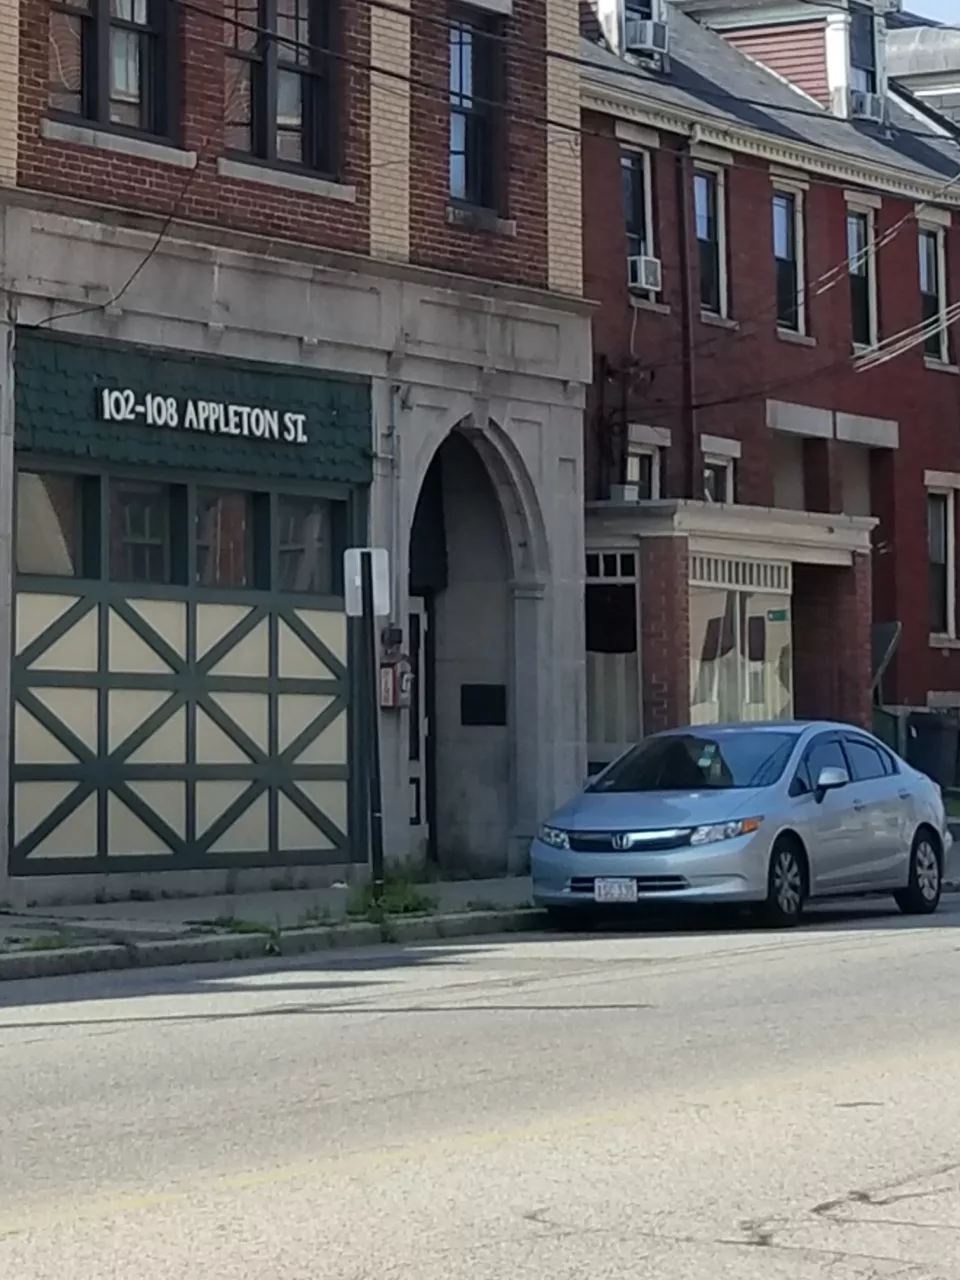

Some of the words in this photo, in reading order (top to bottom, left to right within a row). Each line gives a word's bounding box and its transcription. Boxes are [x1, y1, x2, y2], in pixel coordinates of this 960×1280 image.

[102, 388, 179, 427] 102-108
[184, 399, 279, 439] APPLETON
[283, 412, 308, 442] ST.
